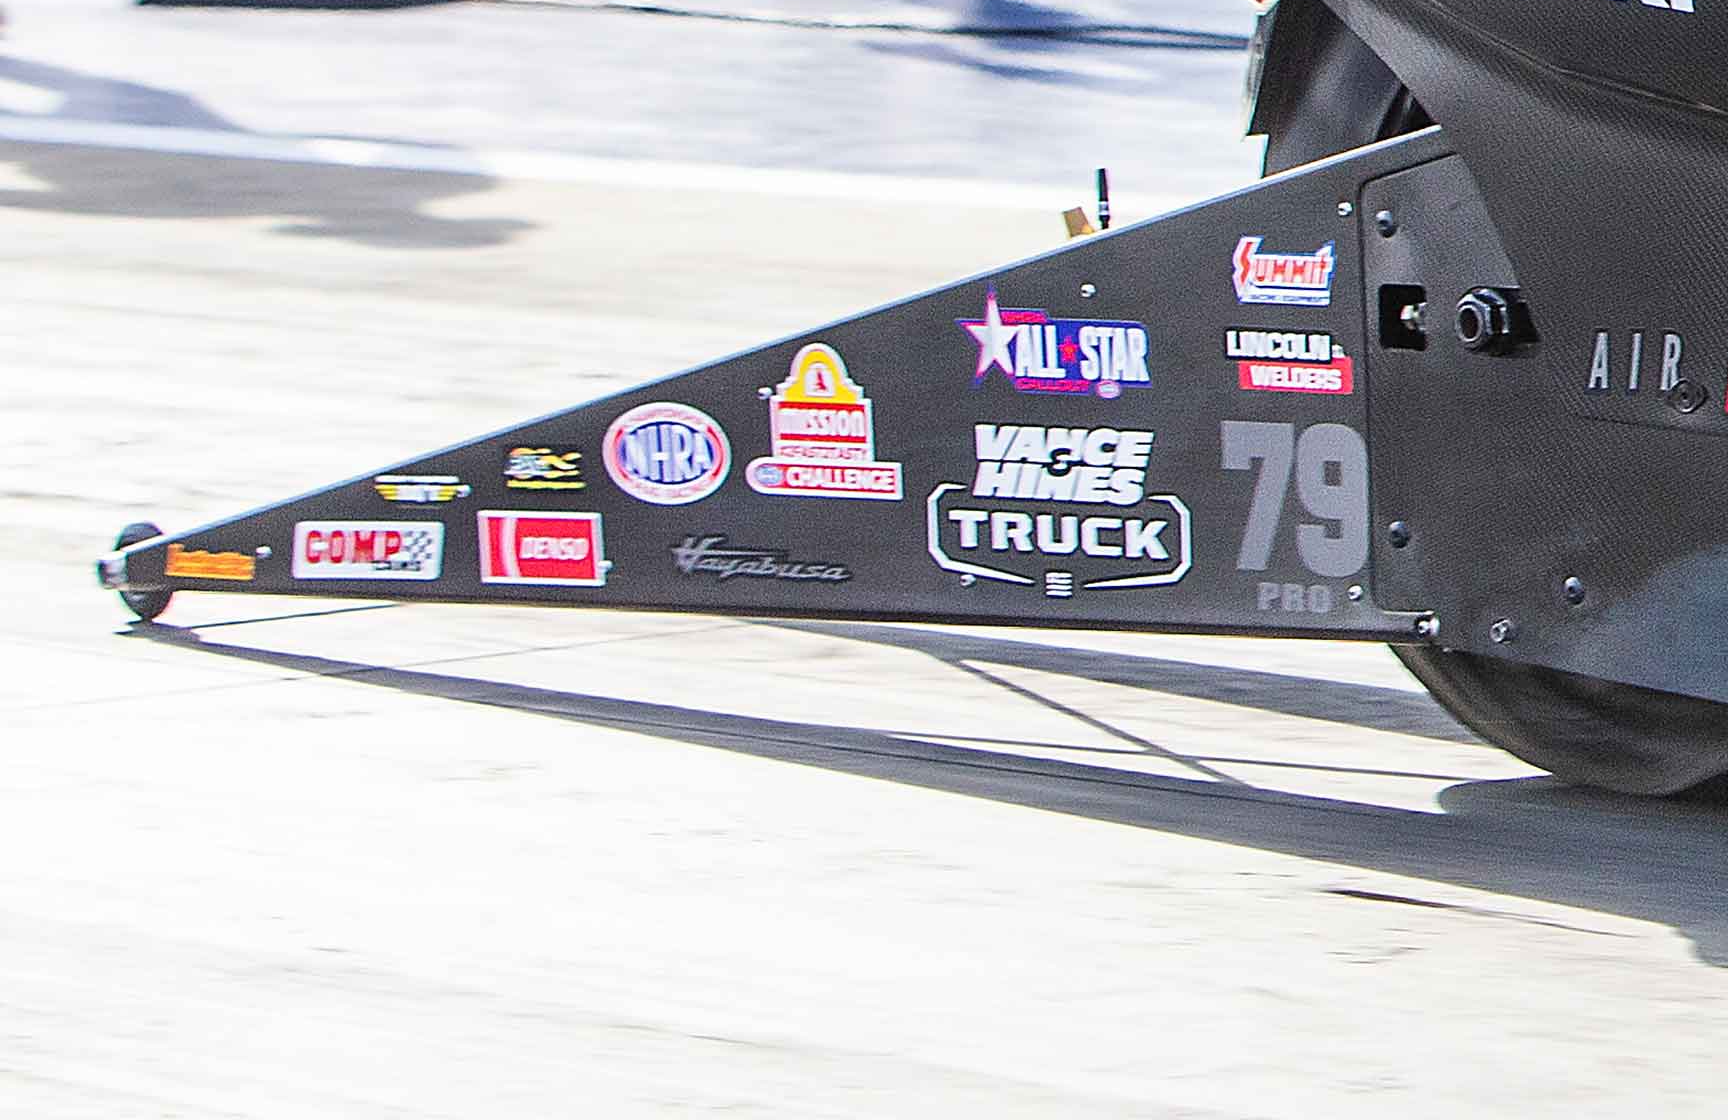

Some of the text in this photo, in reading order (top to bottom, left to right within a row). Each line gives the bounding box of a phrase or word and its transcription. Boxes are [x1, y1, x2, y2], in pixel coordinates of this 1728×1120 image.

[1015, 324, 1150, 381] ALL STAR
[1226, 330, 1331, 361] LINCOLN
[1587, 332, 1682, 392] AIR
[1250, 365, 1343, 391] WELDERS
[622, 421, 716, 483] NHRA
[974, 423, 1155, 468] VANCE
[972, 460, 1146, 506] HINES
[1220, 420, 1370, 579] 79
[305, 530, 402, 564] COMP
[518, 537, 590, 561] DENSO
[948, 509, 1170, 561] TRUCK
[672, 536, 850, 580] Hayabusa
[1256, 582, 1336, 614] PRO
